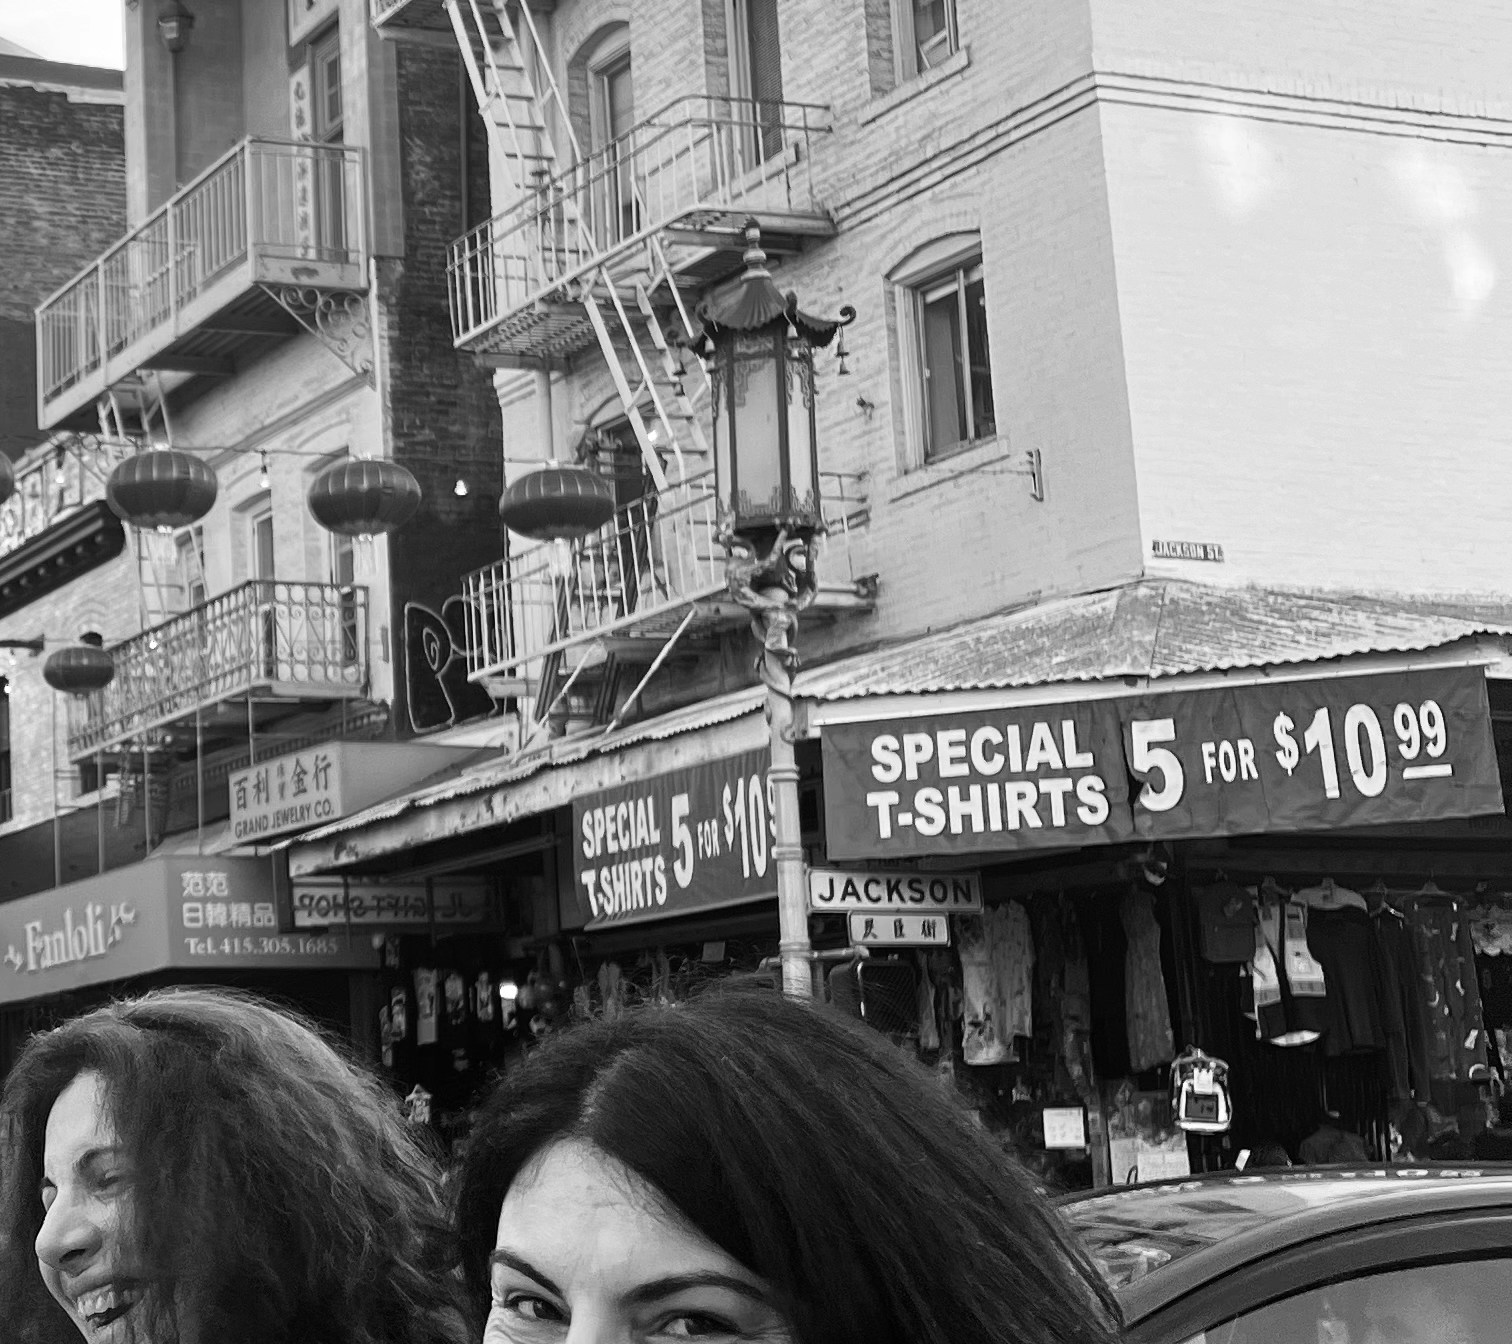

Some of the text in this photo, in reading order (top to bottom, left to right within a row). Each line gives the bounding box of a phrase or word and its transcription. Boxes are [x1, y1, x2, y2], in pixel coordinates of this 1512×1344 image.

[1155, 541, 1204, 560] JACKSON
[870, 718, 1093, 784] SPECIAL
[1130, 718, 1184, 812] 5
[1200, 737, 1260, 785] FOR
[235, 798, 334, 839] GRAND JEWELRY CO.
[582, 795, 660, 859] SPECIAL
[867, 775, 1111, 839] T-SHIRTS
[671, 793, 694, 888] 5
[697, 818, 720, 860] FOR
[581, 855, 667, 917] T-SHIRTS
[819, 876, 973, 904] JACKSON
[184, 937, 217, 954] Tel.
